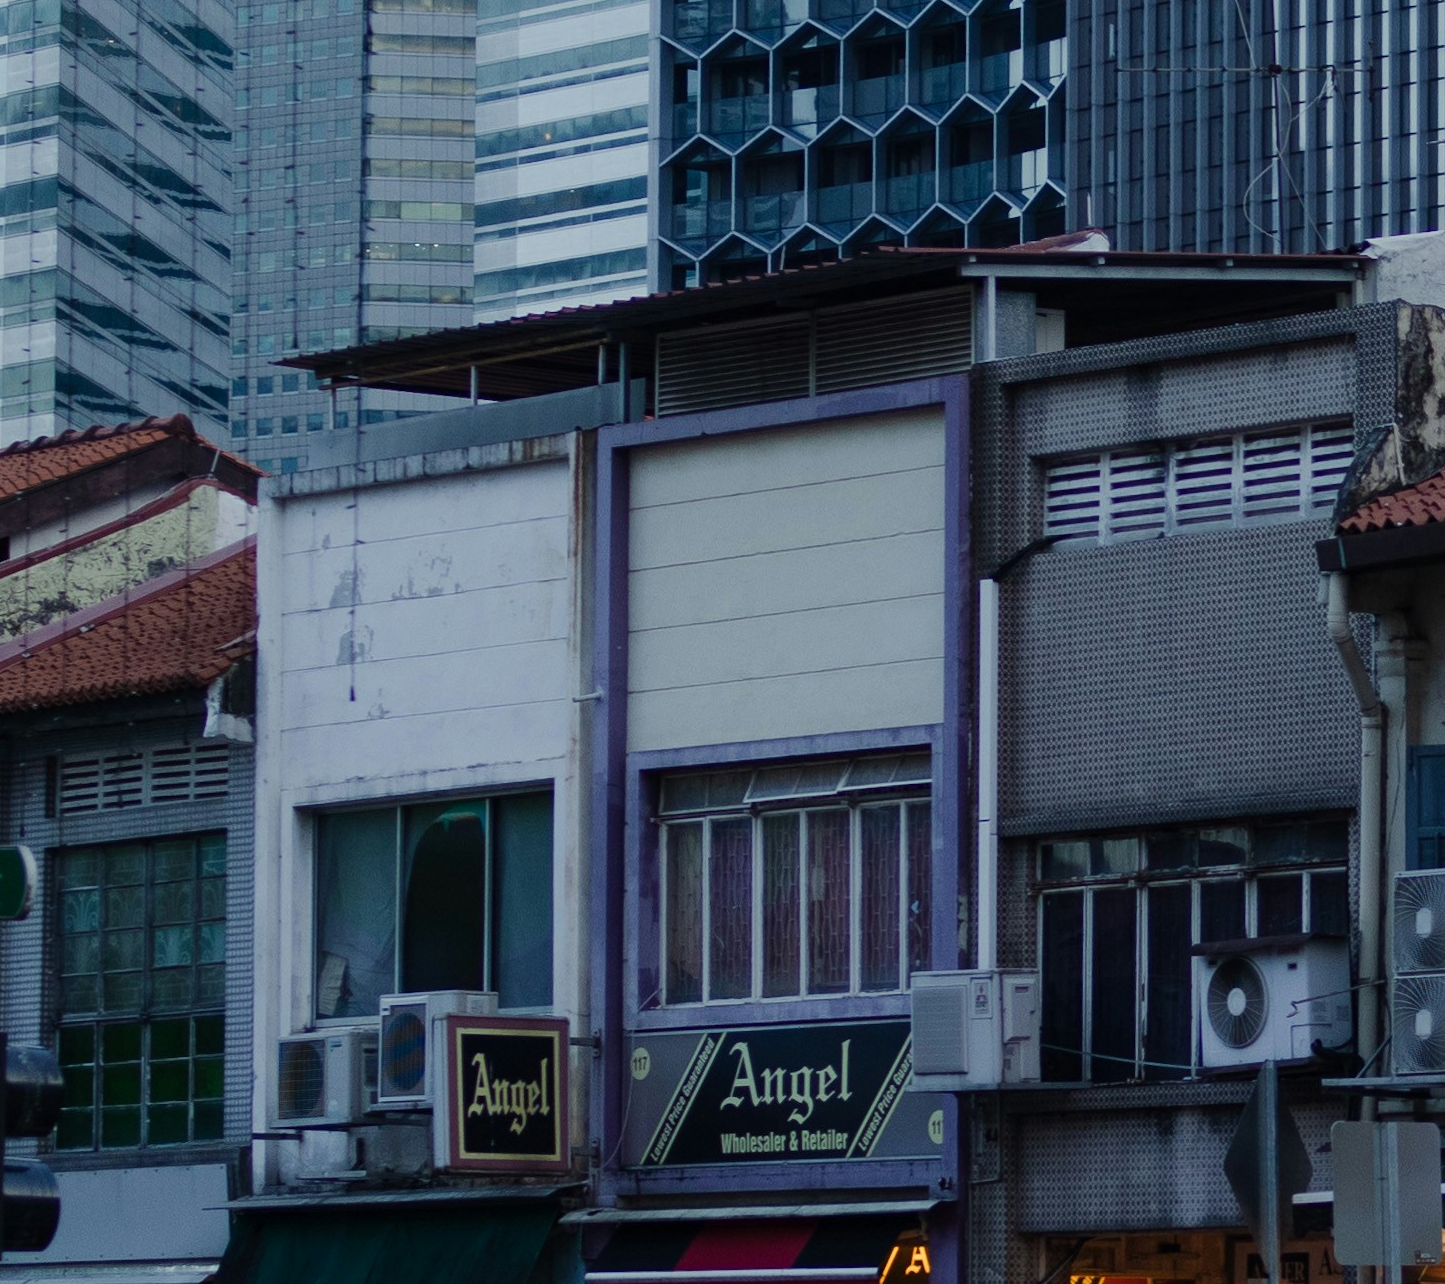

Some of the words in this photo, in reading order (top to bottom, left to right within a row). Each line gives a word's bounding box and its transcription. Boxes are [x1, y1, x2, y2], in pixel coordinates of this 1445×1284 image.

[467, 1052, 550, 1135] Angel
[633, 1056, 648, 1072] 117
[650, 1124, 672, 1162] Lowest
[669, 1096, 686, 1125] Price
[682, 1037, 715, 1096] Guaranteed
[719, 1038, 853, 1125] Angel
[720, 1132, 786, 1154] Wholesaler
[789, 1131, 798, 1151] &
[801, 1129, 849, 1151] Retailer
[858, 1111, 882, 1152] Lowest
[877, 1084, 897, 1115] Price
